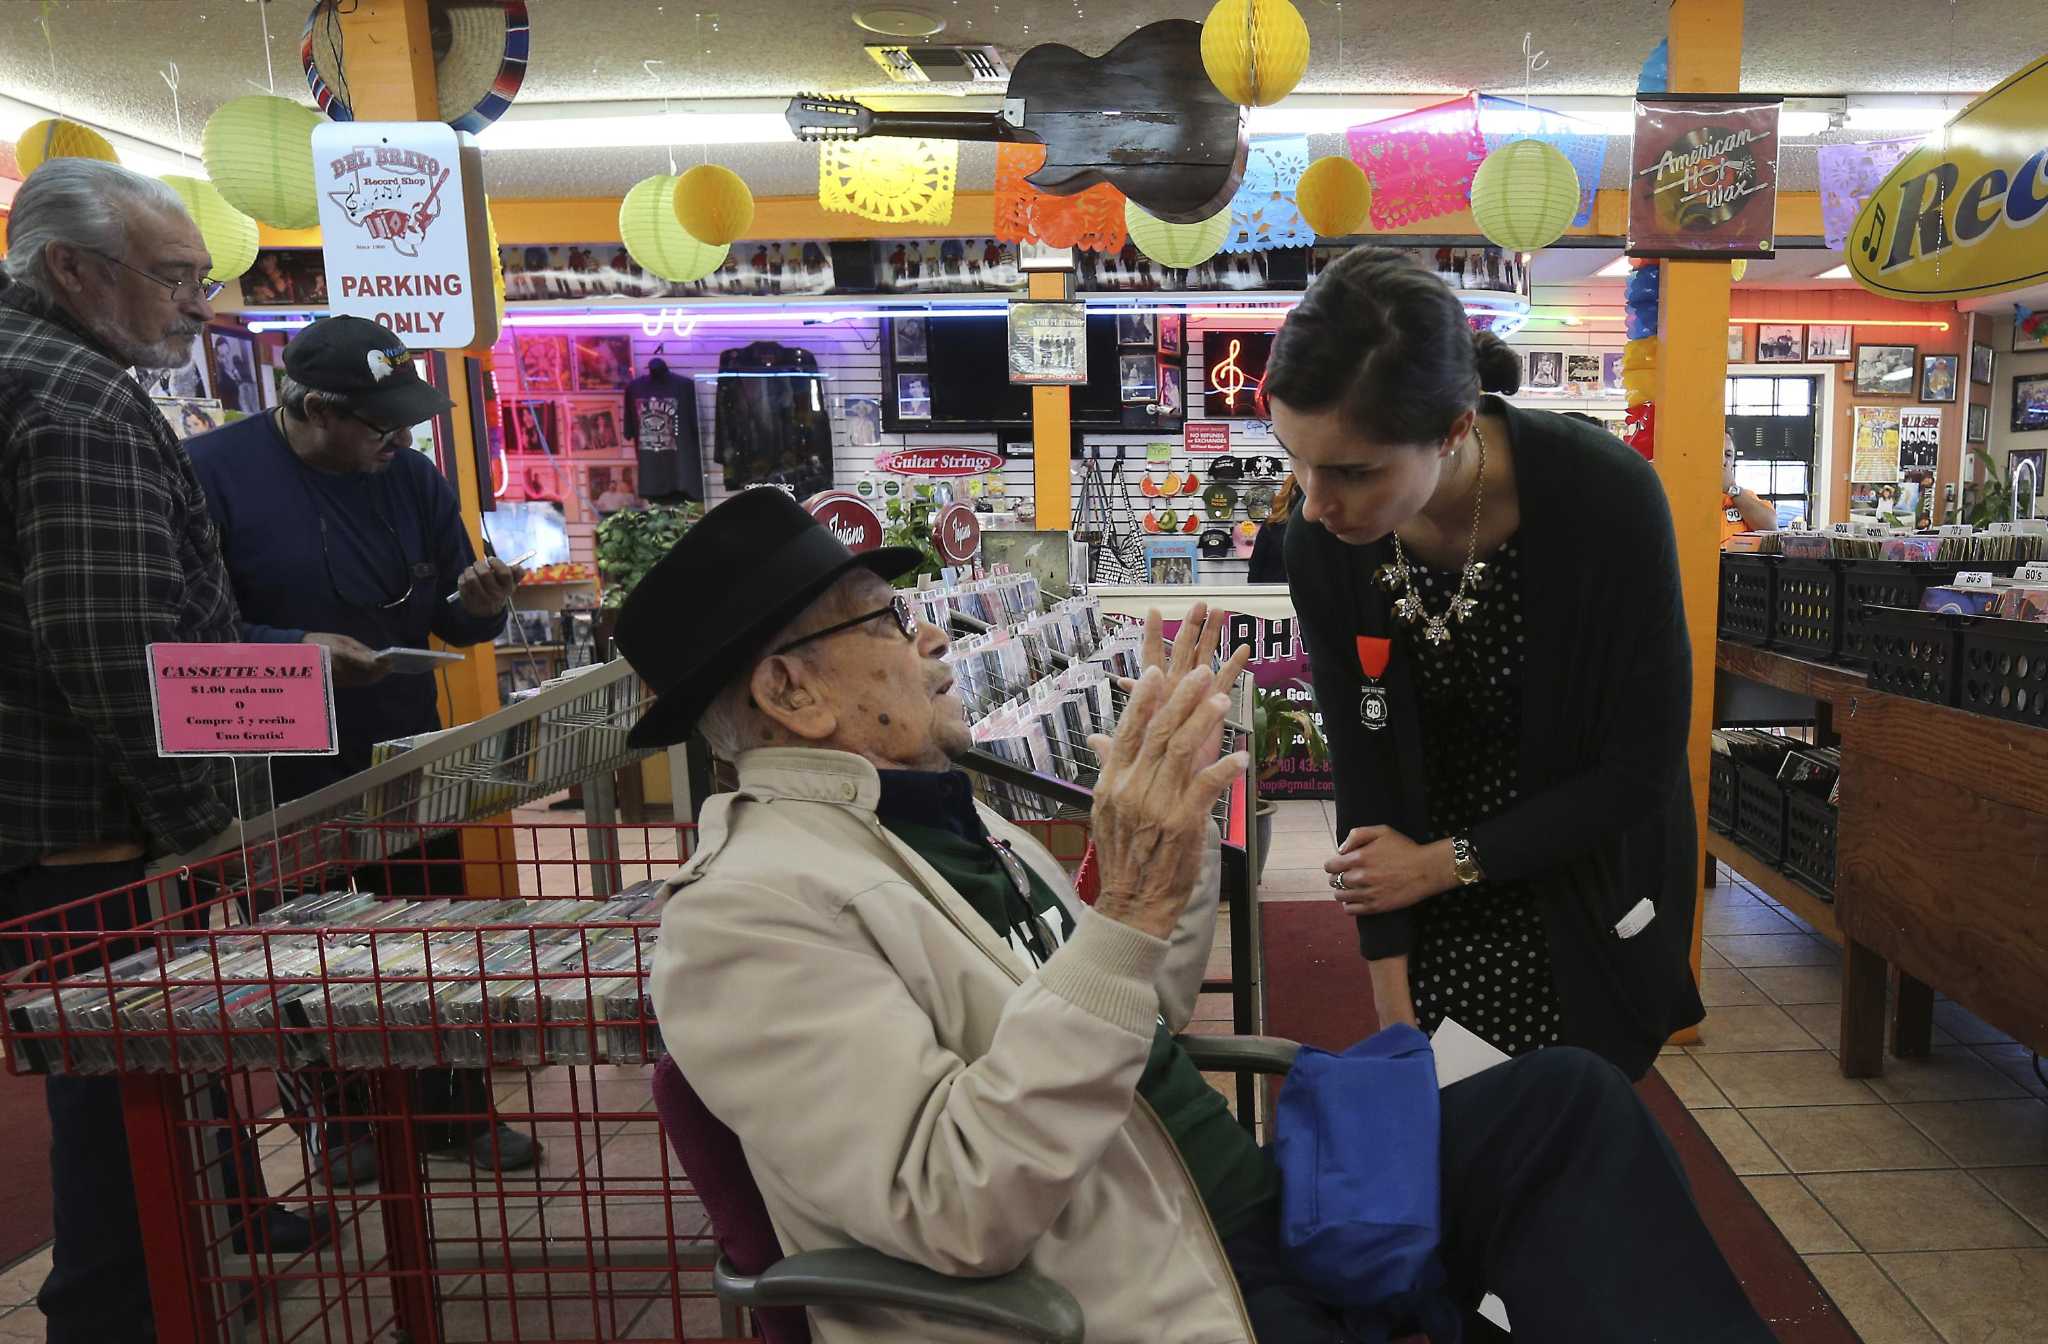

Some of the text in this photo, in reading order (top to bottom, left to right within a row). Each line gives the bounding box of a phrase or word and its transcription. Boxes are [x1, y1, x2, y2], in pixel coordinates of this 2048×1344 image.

[1641, 128, 1769, 181] American
[330, 148, 440, 179] DEL BRAVO
[363, 177, 425, 186] Record Shop
[341, 274, 463, 297] PARKING
[374, 312, 445, 333] ONLY
[892, 454, 991, 472] Guitar Strings
[1727, 510, 1740, 518] 90
[2000, 523, 2011, 532] 70's
[2025, 569, 2043, 581] 80's
[162, 666, 313, 678] CASSETTE SALE
[191, 686, 226, 695] $1.00
[229, 686, 257, 695] cada
[1367, 703, 1379, 714] 90
[186, 716, 233, 726] Compre
[249, 717, 254, 726] y
[215, 732, 284, 741] Uno Gratis!
